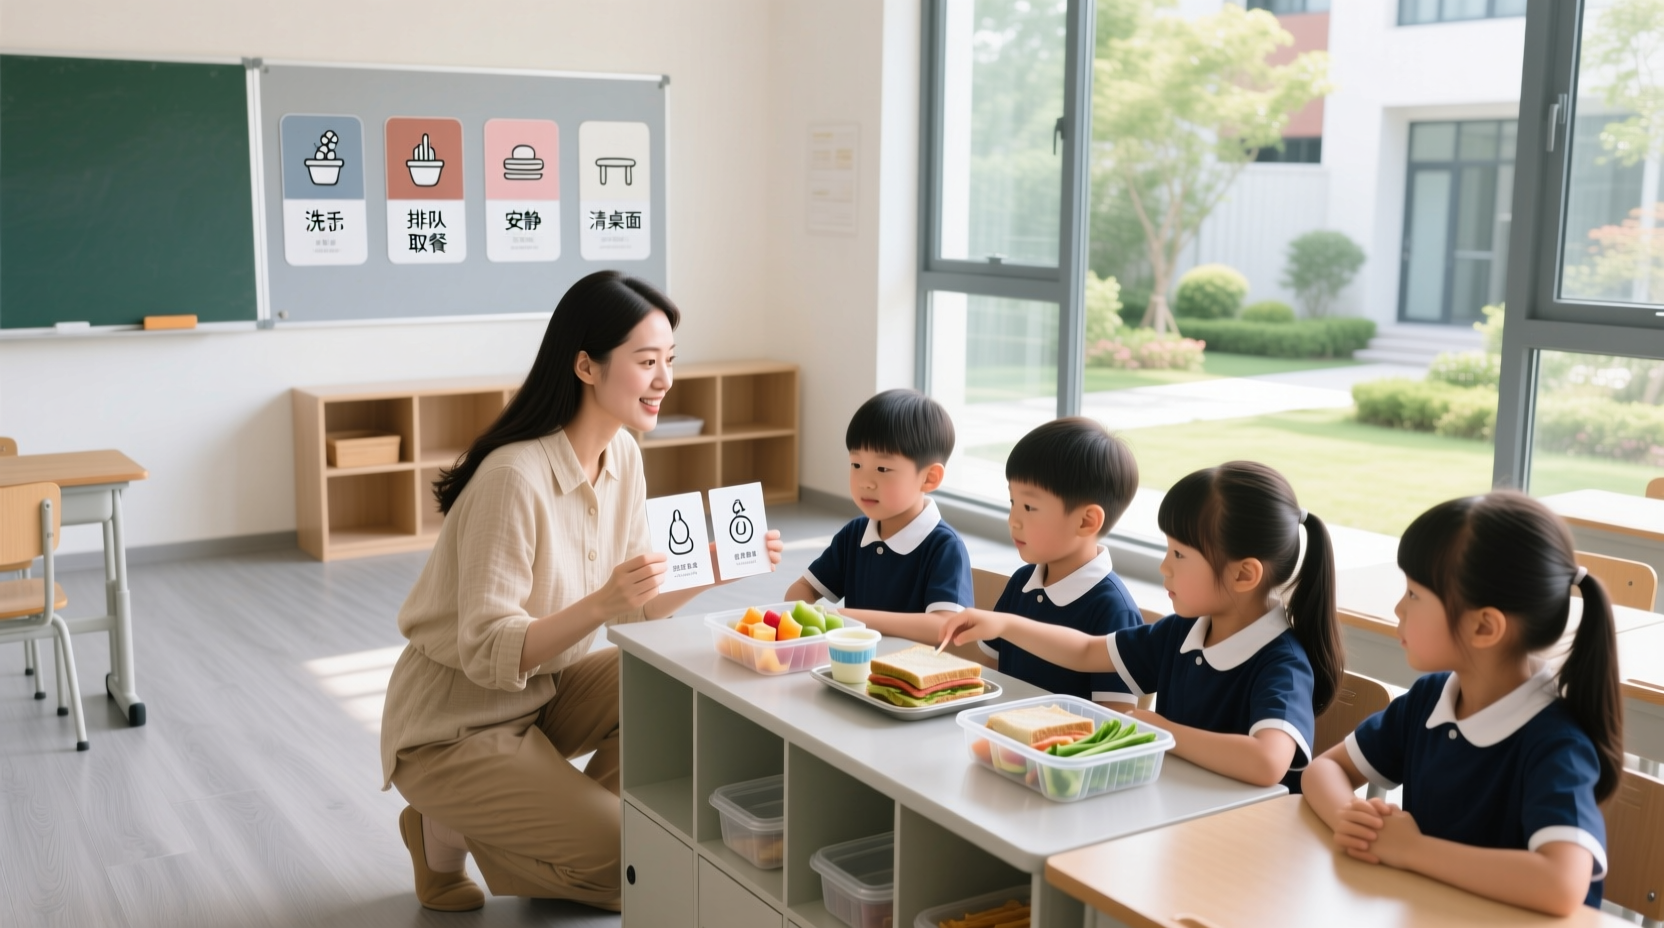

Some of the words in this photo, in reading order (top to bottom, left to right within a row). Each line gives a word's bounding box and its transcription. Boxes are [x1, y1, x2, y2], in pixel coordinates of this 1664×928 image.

[407, 209, 447, 230] 排队
[505, 210, 542, 231] 安静
[589, 210, 642, 231] 清桌面
[408, 233, 448, 254] 取餐
